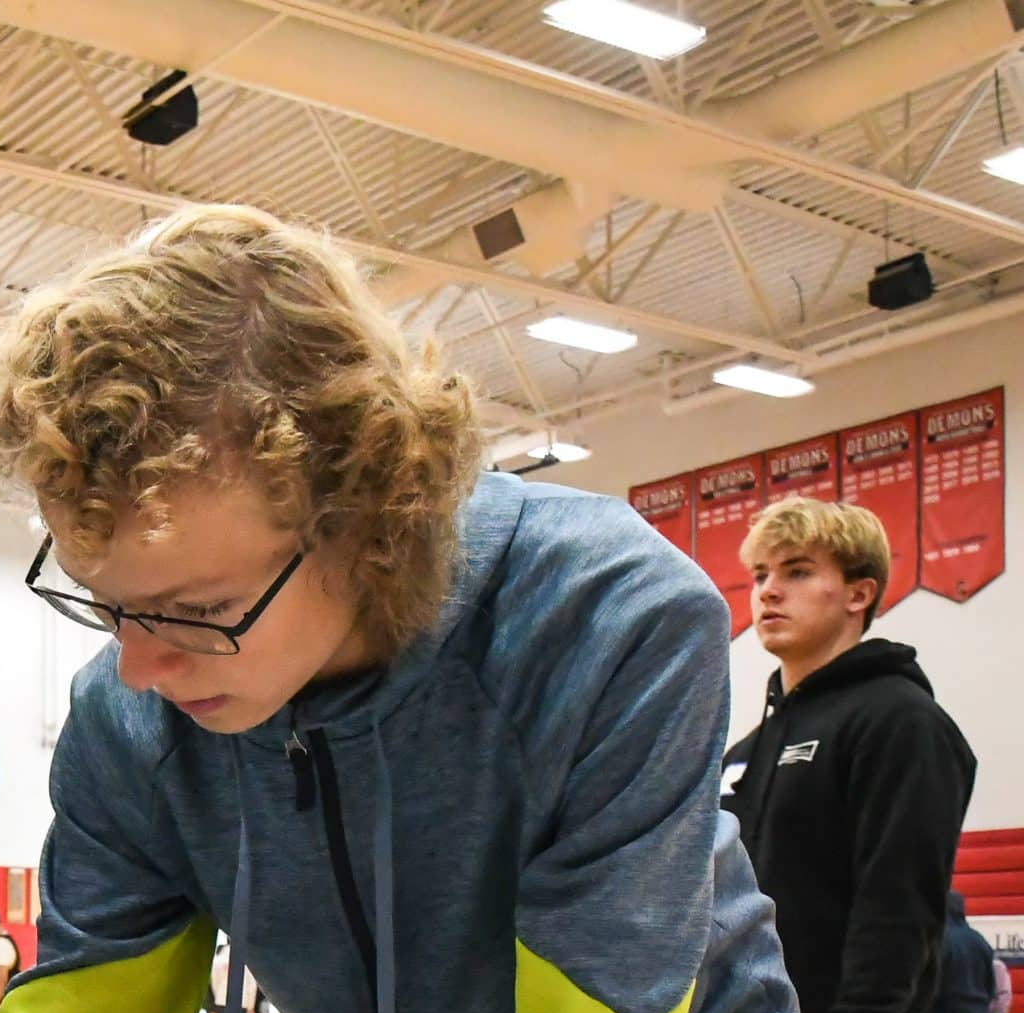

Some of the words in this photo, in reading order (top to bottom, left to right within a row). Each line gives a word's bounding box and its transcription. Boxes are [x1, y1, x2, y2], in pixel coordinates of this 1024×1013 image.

[927, 404, 994, 435] DEMONS
[846, 428, 909, 455] DEMONS
[770, 449, 829, 476] DEMONS
[700, 470, 755, 494] DEMONS
